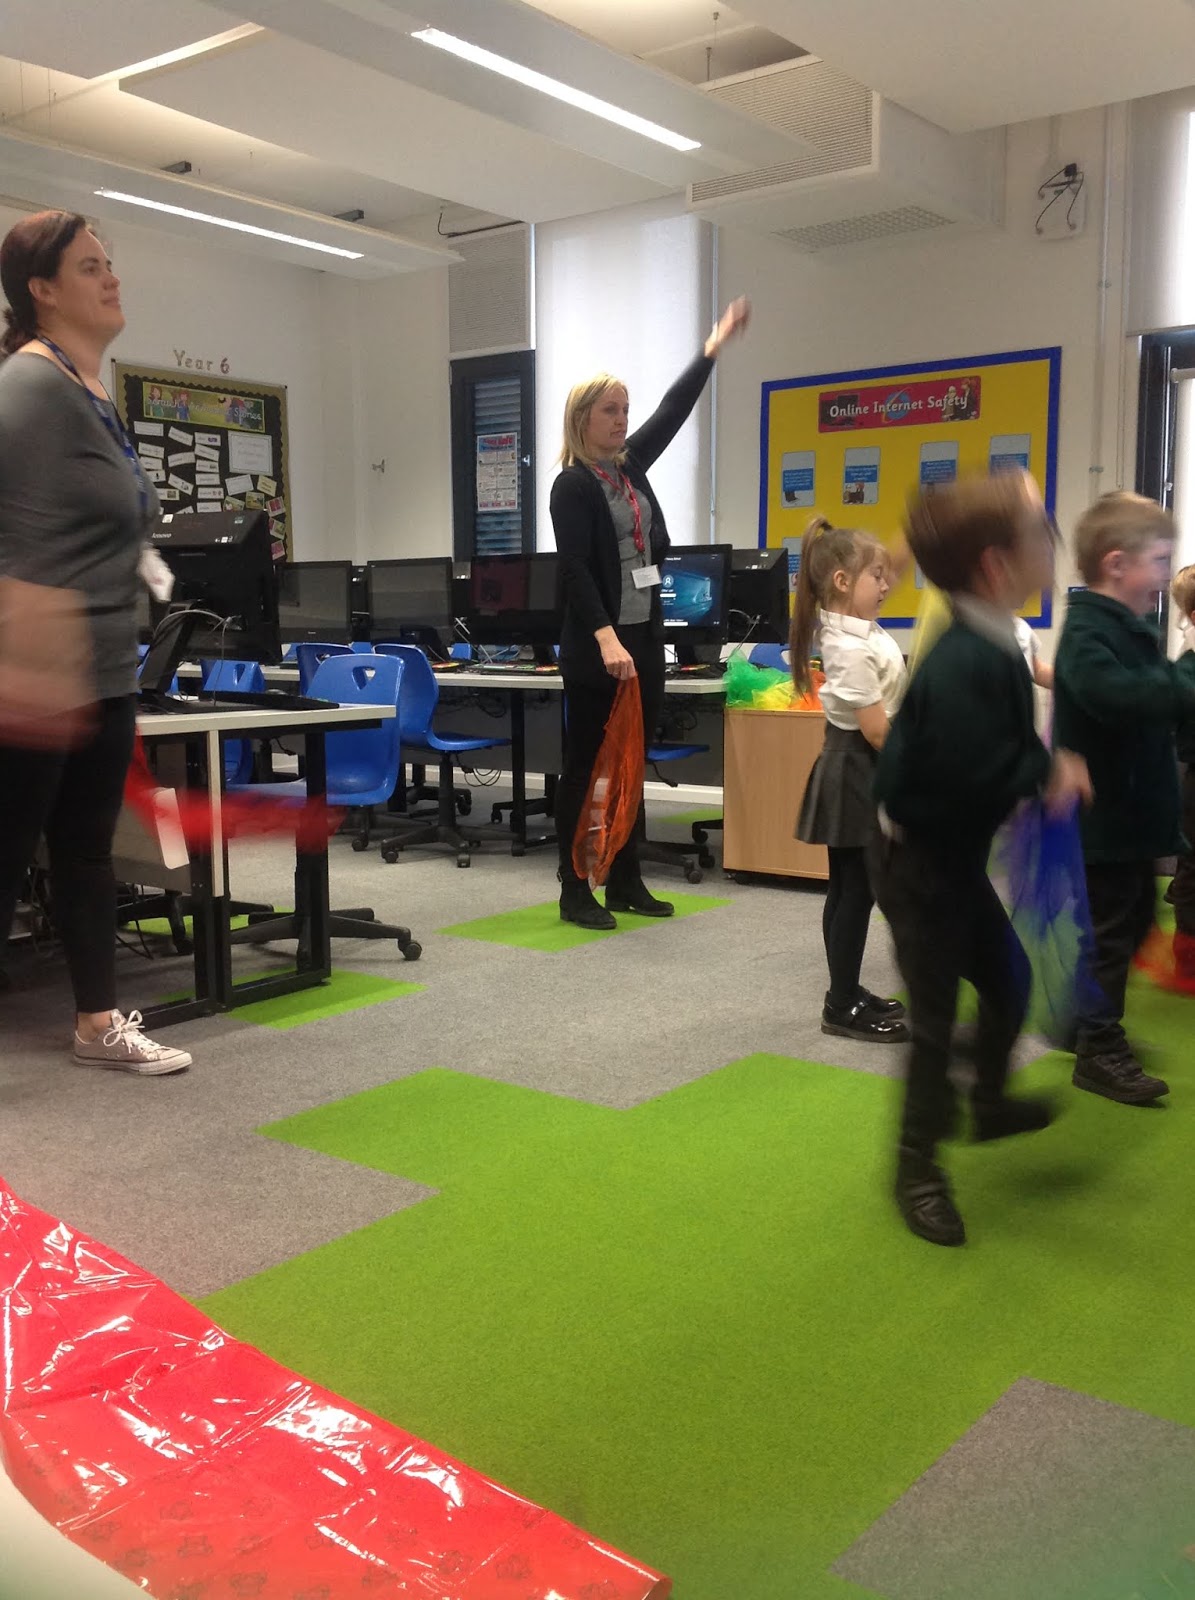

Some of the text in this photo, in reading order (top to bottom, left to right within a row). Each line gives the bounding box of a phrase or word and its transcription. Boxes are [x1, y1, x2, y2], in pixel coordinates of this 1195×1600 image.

[173, 349, 230, 374] Year 6
[829, 394, 968, 418] Online Internet Safety
